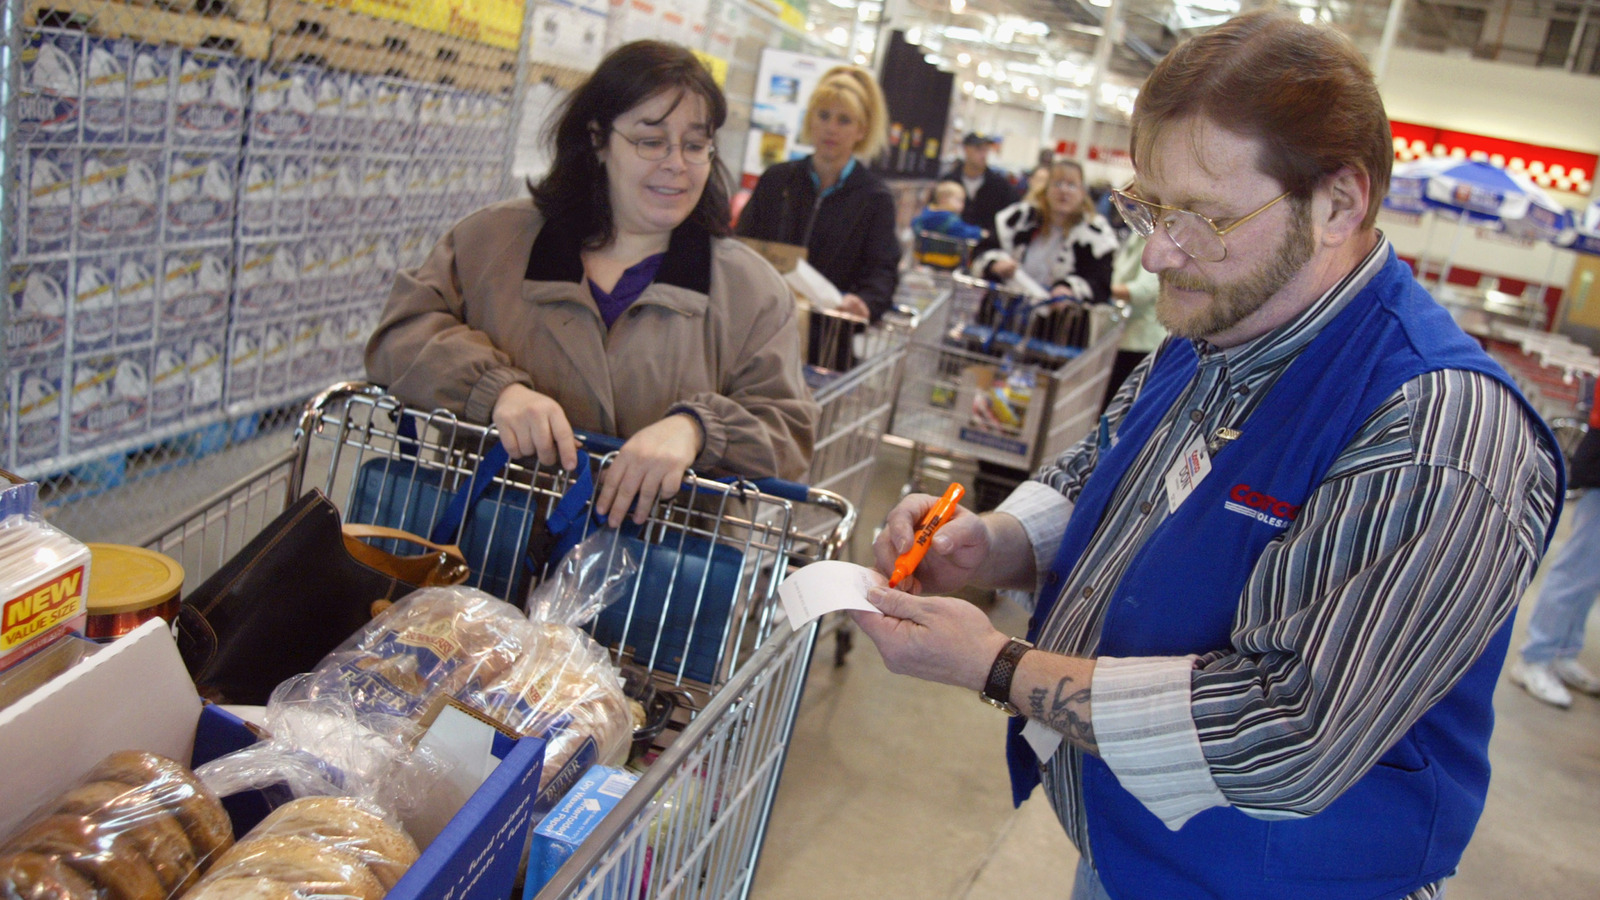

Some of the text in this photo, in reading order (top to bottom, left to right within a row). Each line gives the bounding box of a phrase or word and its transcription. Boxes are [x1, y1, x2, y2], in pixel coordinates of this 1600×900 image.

[1230, 483, 1302, 521] COTCO
[7, 571, 81, 627] NEW
[6, 600, 78, 645] VALUE SIZE
[543, 758, 581, 802] BUTTER
[580, 780, 595, 792] Dry
[561, 791, 586, 813] Waxed
[545, 812, 567, 833] Paper
[468, 834, 495, 874] fund
